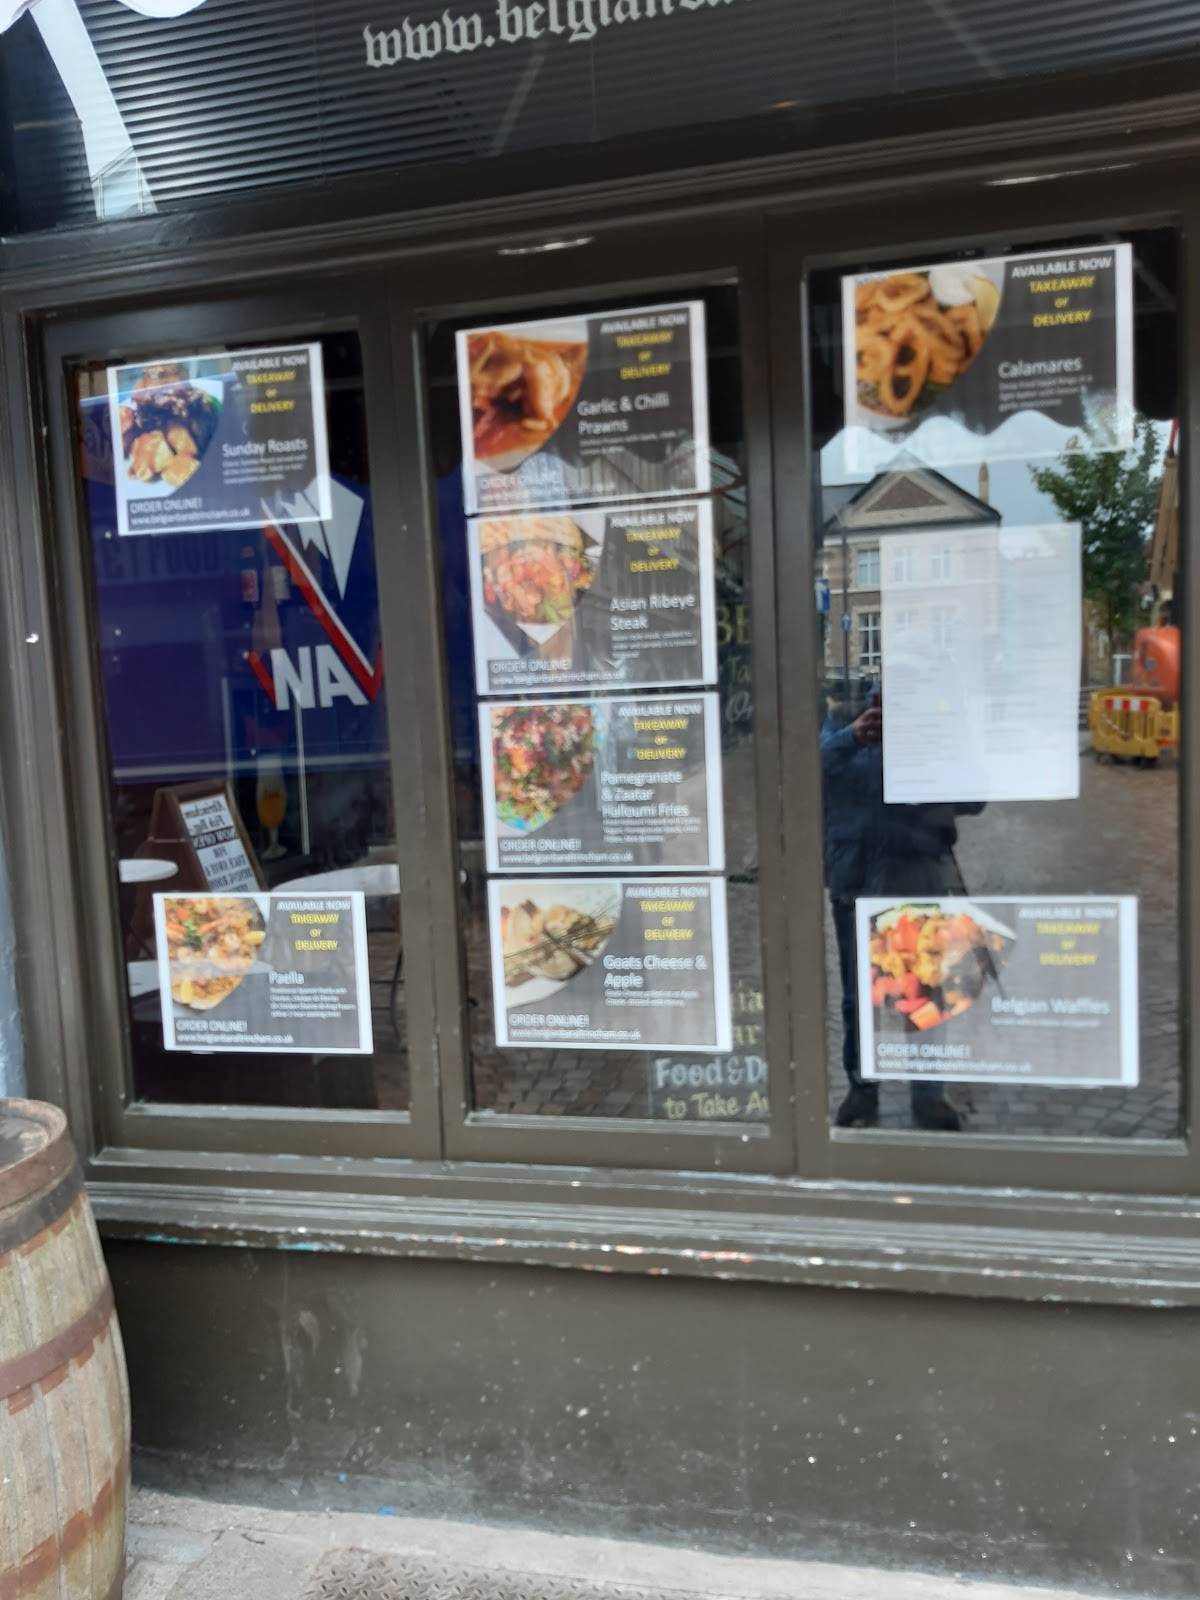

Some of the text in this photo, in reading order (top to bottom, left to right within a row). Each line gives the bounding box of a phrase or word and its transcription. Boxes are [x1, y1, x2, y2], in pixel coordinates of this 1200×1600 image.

[363, 0, 734, 68] www.belgian
[1011, 256, 1112, 279] AVAILABLE NOW
[1029, 275, 1096, 294] TAKEAWAY
[601, 312, 687, 333] AVAILABLE NOW
[1033, 310, 1092, 328] DELIVERY
[616, 331, 673, 347] TAKEAWAY
[232, 354, 307, 371] AVAILABLE NOW
[998, 357, 1082, 379] Calamares
[246, 371, 296, 385] TAKEAWAY
[620, 364, 671, 379] DELIVERY
[251, 400, 294, 414] DELIVERY
[577, 392, 670, 416] Garlic & Chilli
[578, 419, 629, 435] Prawns
[222, 439, 308, 458] Sunday Roasts
[130, 502, 161, 514] ORDER
[610, 510, 695, 528] AVAILABLE NOW
[625, 528, 681, 543] TAKEAWAY
[630, 559, 679, 573] DELIVERY
[609, 593, 696, 611] Asian Ribeye
[610, 615, 648, 630] Steak
[618, 702, 702, 718] AVAILABLE NOW
[634, 719, 688, 732] TAKEAWAY
[637, 748, 687, 760] DELIVERY
[601, 771, 683, 787] Pomegranate
[601, 787, 655, 801] & Zaatar
[602, 803, 689, 817] Halloumi Fries
[502, 838, 536, 851] ORDER
[625, 886, 708, 899] AVAILABLE NOW
[276, 900, 351, 911] AVAILABLE NOW
[639, 900, 697, 913] TAKEAWAY
[1018, 906, 1117, 920] AVAILABLE NOW
[290, 914, 339, 924] TAKEAWAY
[643, 929, 695, 941] DELIVERY
[1036, 922, 1101, 936] TAKEAWAY
[295, 940, 338, 951] DELIVERY
[603, 954, 707, 970] Goats Cheese &
[1039, 953, 1097, 967] DELIVERY
[268, 970, 305, 985] Paella
[604, 972, 644, 989] Apple
[991, 996, 1111, 1016] Belgian Waffles
[176, 1020, 208, 1032] ORDER
[510, 1014, 545, 1027] ORDER
[878, 1043, 918, 1057] ORDER
[655, 1055, 723, 1088] Food
[744, 1055, 769, 1085] D
[663, 1097, 688, 1119] to
[690, 1091, 738, 1117] Take
